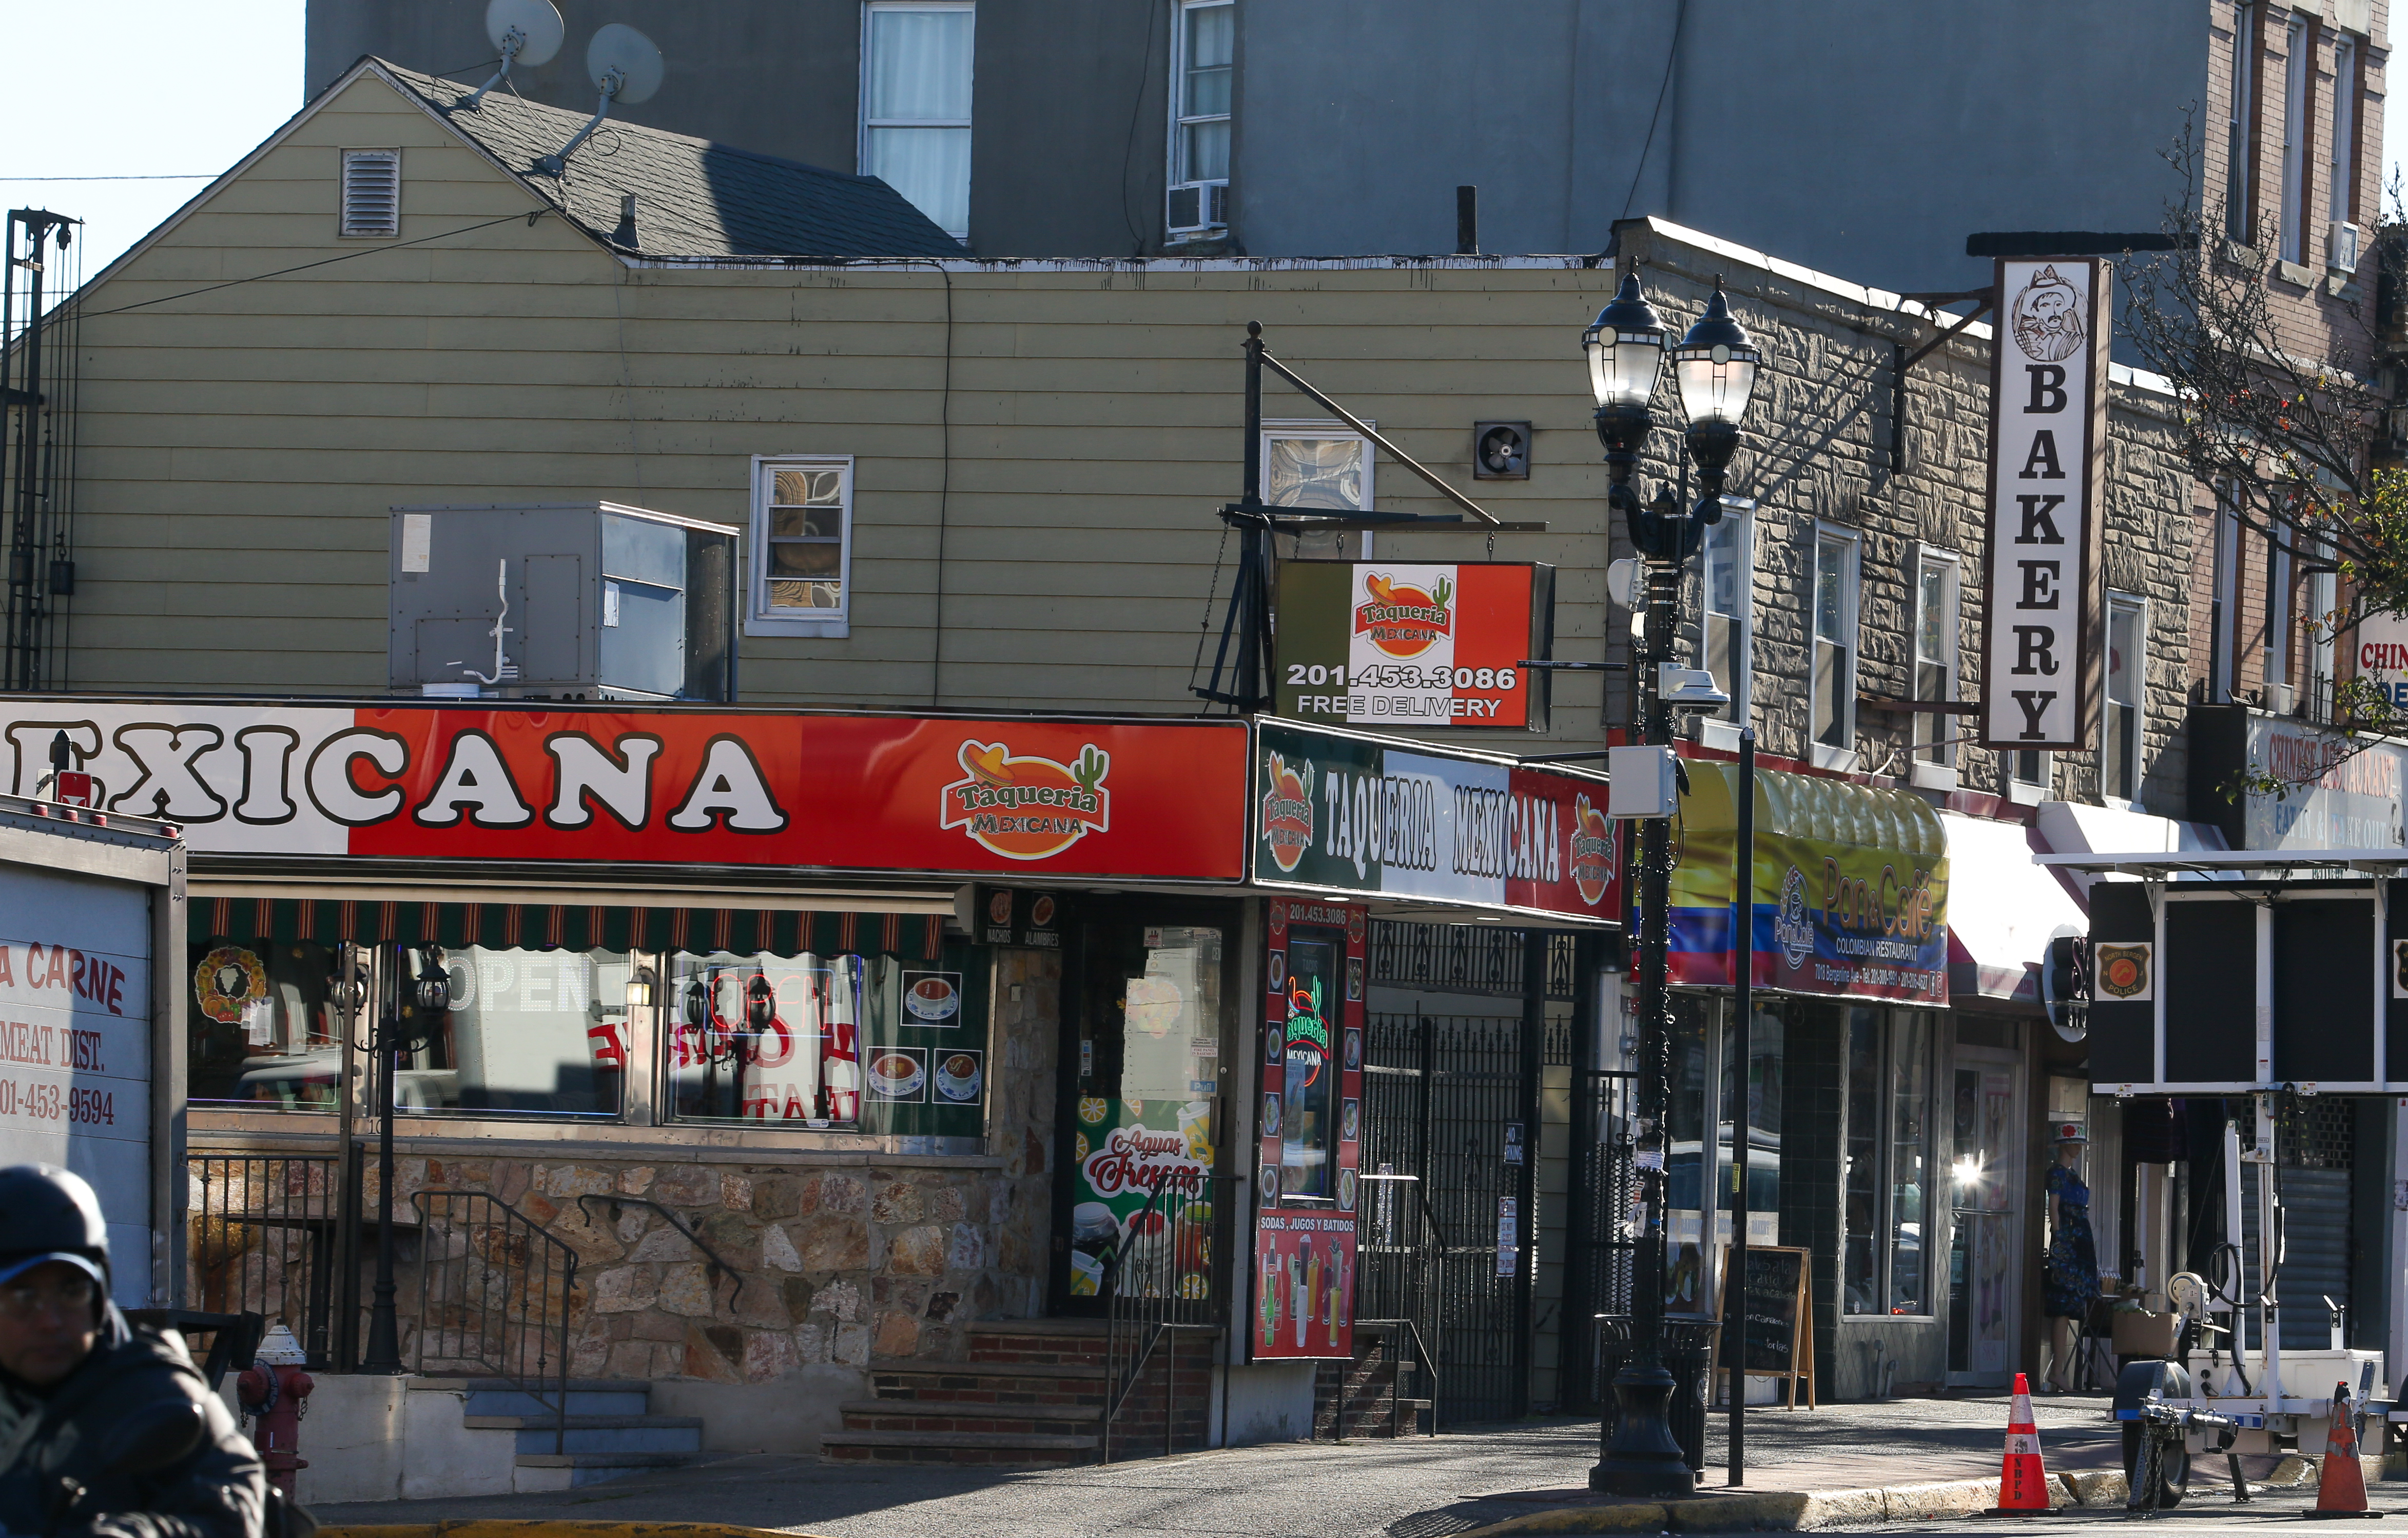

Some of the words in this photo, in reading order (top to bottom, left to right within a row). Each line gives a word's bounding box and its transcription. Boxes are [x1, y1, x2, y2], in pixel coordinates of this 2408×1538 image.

[2010, 363, 2068, 741] BAKERY
[1363, 604, 1447, 625] Taqueria
[1370, 626, 1438, 641] MEXICANA
[2361, 643, 2408, 669] CHIN
[1286, 664, 1516, 690] 201.453.3086
[1297, 695, 1366, 715] FREE
[1372, 696, 1502, 718] DELIVERY
[2269, 733, 2317, 787] CHINESE
[2320, 742, 2396, 800] RESTAURANT
[956, 784, 1098, 813] Taqueria
[1267, 796, 1310, 826] Taqueria
[970, 813, 1083, 835] MEXICANA
[1325, 771, 1436, 880] TAQUERIA
[1452, 784, 1561, 883] MEXICANA
[2275, 803, 2297, 837] EAT
[2331, 813, 2361, 847] TAKE
[2363, 819, 2387, 850] OUT
[1574, 833, 1614, 862] Taqueria
[1290, 903, 1347, 925] 201.453.3086
[987, 929, 1012, 944] NACHOS
[1025, 931, 1059, 947] ALAMBRES
[1836, 937, 1874, 956] COLOMBIAN
[1876, 940, 1918, 962] RESTAURANT
[2104, 951, 2122, 962] NORTH
[2123, 950, 2144, 962] BERGEN
[27, 941, 125, 1016] CARNE
[445, 956, 590, 1012] OPEN
[1826, 965, 1850, 985] Bergenline
[710, 973, 829, 1031] OPEN
[2108, 984, 2138, 995] POLICE
[60, 1028, 105, 1072] DIST.
[1111, 1130, 1183, 1161] Aguas
[1508, 1127, 1515, 1142] NO
[1089, 1151, 1202, 1193] Frescas
[1290, 1218, 1315, 1231] JUGOS
[1316, 1219, 1323, 1231] Y
[1323, 1219, 1354, 1232] BATIDOS
[2013, 1458, 2023, 1500] NBPD
